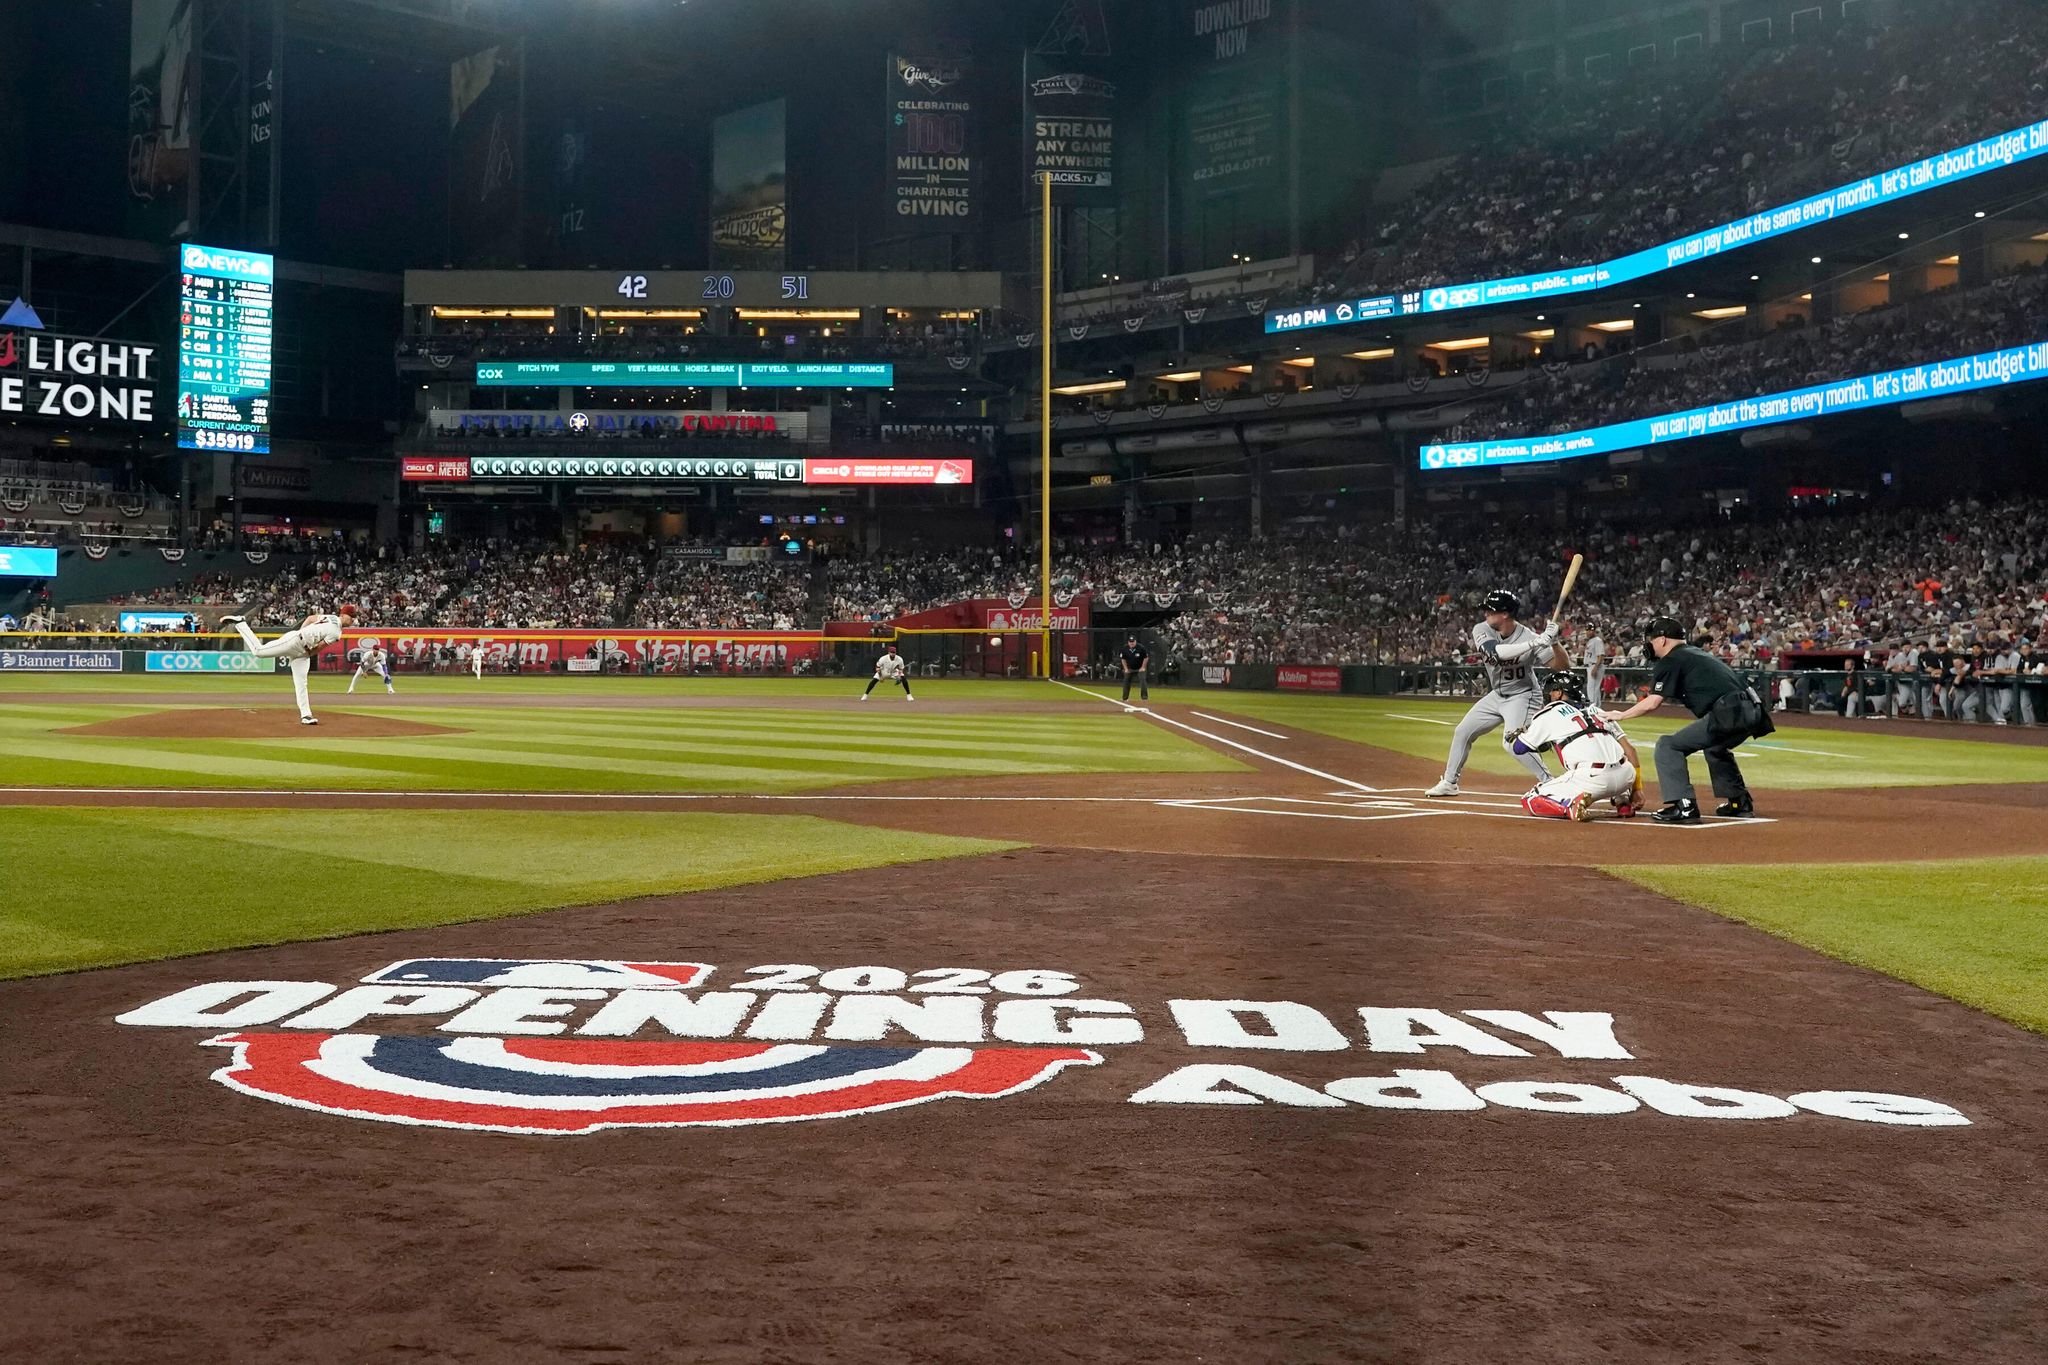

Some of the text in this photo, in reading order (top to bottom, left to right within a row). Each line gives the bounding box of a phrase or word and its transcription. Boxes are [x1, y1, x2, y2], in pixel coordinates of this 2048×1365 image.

[1194, 0, 1270, 36] DOWNLOAD
[1216, 26, 1248, 60] NOW
[898, 101, 970, 111] CELEBRATING
[1035, 122, 1112, 138] STREAM
[1036, 141, 1112, 153] ANY GAME
[897, 157, 969, 171] MILLION
[1035, 155, 1112, 167] ANYWHERE
[926, 174, 940, 183] IN
[897, 187, 969, 198] CHARITABLE
[1667, 242, 1684, 267] you
[1685, 237, 1702, 257] can
[1704, 232, 1722, 256] pay
[1723, 221, 1752, 245] about
[1753, 213, 1771, 235] the
[1773, 207, 1801, 228] same
[1802, 196, 1835, 219] every
[1837, 179, 1878, 210] month.
[1881, 169, 1907, 195] let's
[1910, 160, 1934, 186] talk
[1936, 149, 1975, 179] about
[1977, 128, 2027, 165] budget
[897, 200, 969, 215] GIVING
[195, 277, 214, 288] MIN
[618, 276, 647, 298] 42
[702, 276, 734, 298] 20
[781, 276, 808, 299] 51
[1450, 269, 1610, 308] aps arizona. public. service.
[195, 289, 208, 299] KC
[194, 303, 213, 314] TEX
[194, 316, 213, 326] BAL
[1275, 308, 1327, 329] 7:10 PM
[194, 330, 209, 340] PIT
[194, 342, 211, 353] CIN
[28, 337, 154, 380] LIGHT
[193, 358, 213, 368] CWS
[477, 369, 503, 379] COX
[685, 365, 735, 373] HORIZ. BREAK
[751, 365, 768, 373] EXIT
[797, 365, 821, 373] LAUNCH
[194, 371, 213, 381] MIA
[211, 385, 228, 393] DUE
[1651, 421, 1668, 442] you
[1670, 416, 1687, 434] can
[1688, 413, 1707, 436] pay
[1708, 405, 1738, 428] about
[1739, 400, 1757, 420] the
[1759, 397, 1788, 417] same
[1790, 391, 1824, 414] every
[1826, 378, 1869, 406] month.
[1872, 373, 1900, 398] let's
[1901, 367, 1928, 393] talk
[1930, 360, 1970, 388] about
[1973, 348, 2026, 382] budget
[38, 381, 153, 421] ZONE
[202, 395, 229, 404] MARTE
[202, 403, 237, 413] CARROLL
[202, 411, 242, 421] PERDOMO
[188, 419, 261, 433] CURRENT JACKPOT
[682, 415, 777, 432] CANTINA
[195, 428, 254, 450] $35919
[1447, 436, 1595, 467] aps arizona. public. service.
[438, 467, 468, 477] METER
[754, 462, 777, 471] GAME
[784, 464, 795, 478] 0
[753, 471, 777, 480] TOTAL
[18, 654, 112, 667] Banner Health
[161, 654, 203, 669] COX
[218, 654, 260, 669] COX
[1504, 666, 1526, 680] 30
[730, 964, 1079, 995] 2026
[115, 980, 1636, 1059] OPENING DAY
[1127, 1064, 1973, 1126] Adobe
